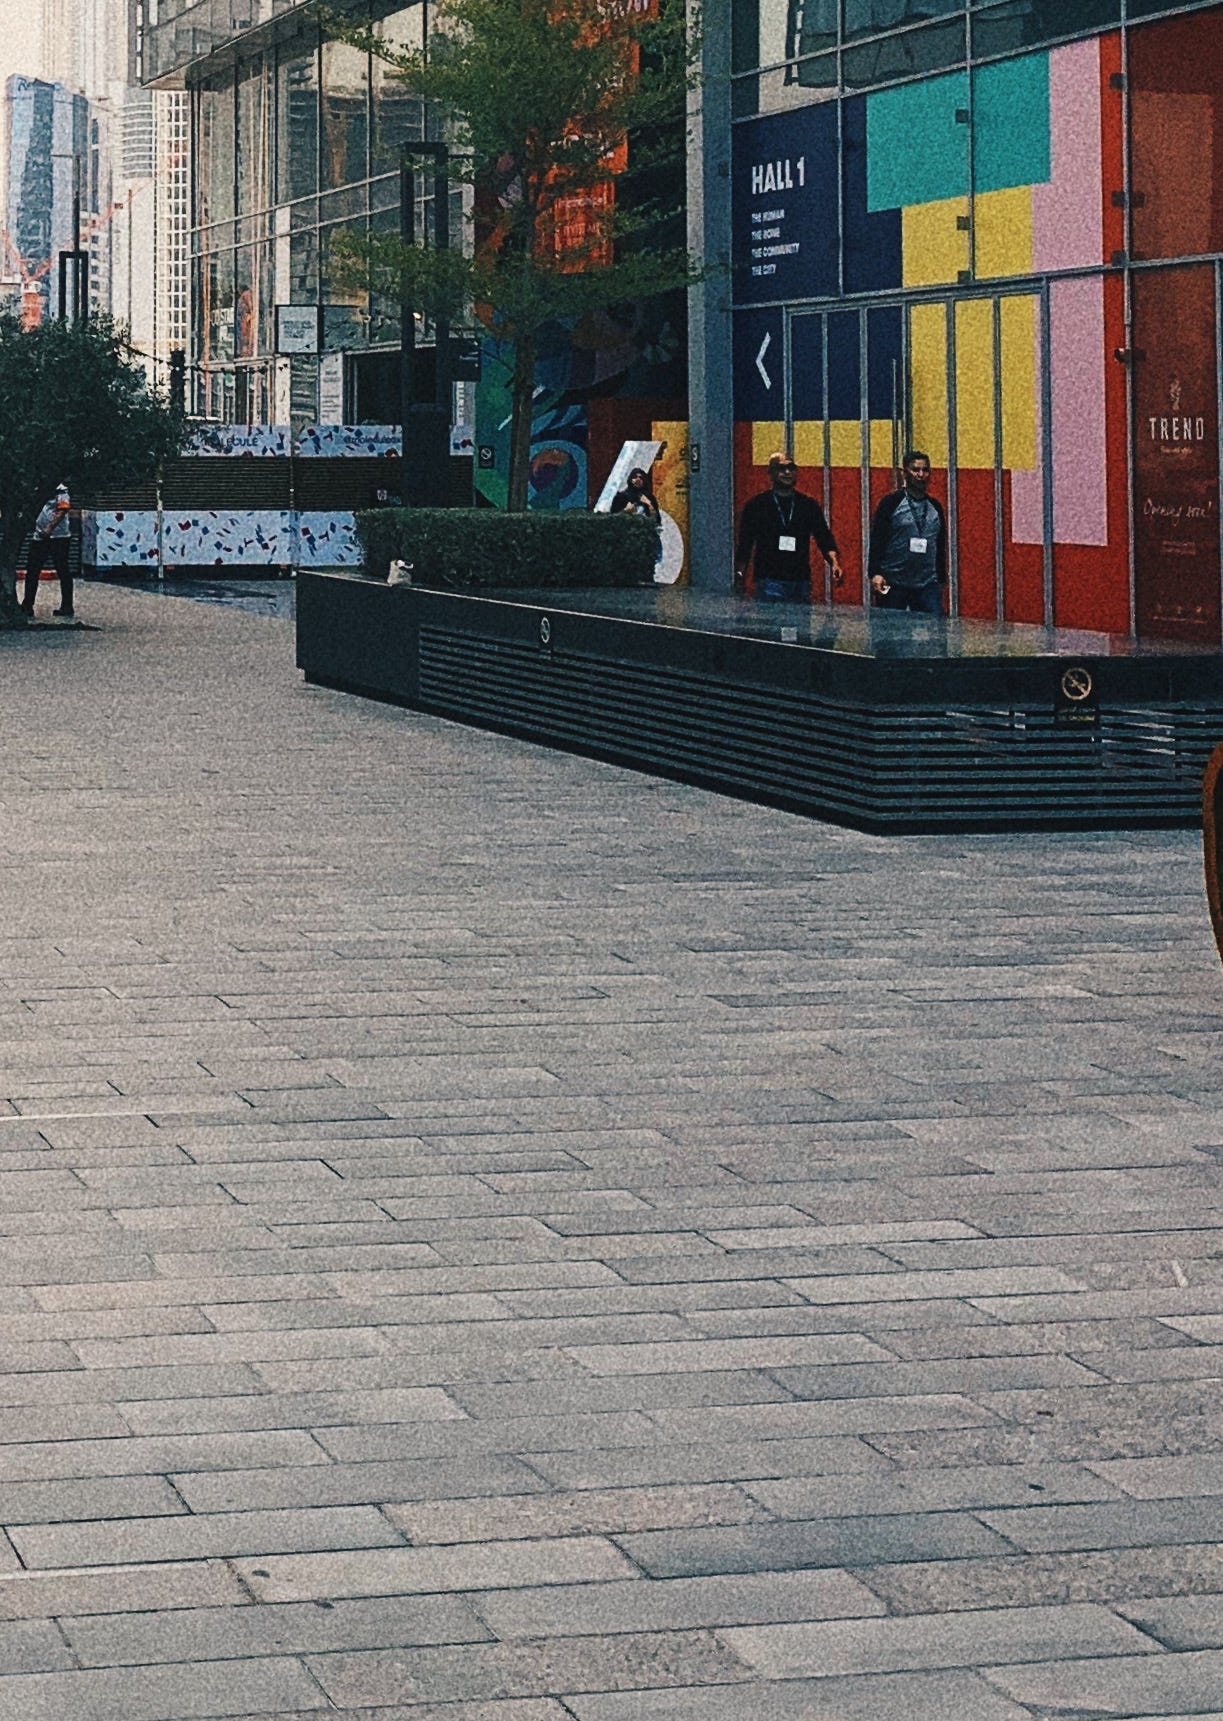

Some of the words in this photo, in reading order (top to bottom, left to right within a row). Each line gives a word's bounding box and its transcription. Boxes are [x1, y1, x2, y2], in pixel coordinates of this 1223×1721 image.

[752, 159, 794, 195] HALL
[796, 156, 805, 186] 1
[762, 242, 800, 257] COMMUNITY
[1149, 417, 1204, 440] TREND
